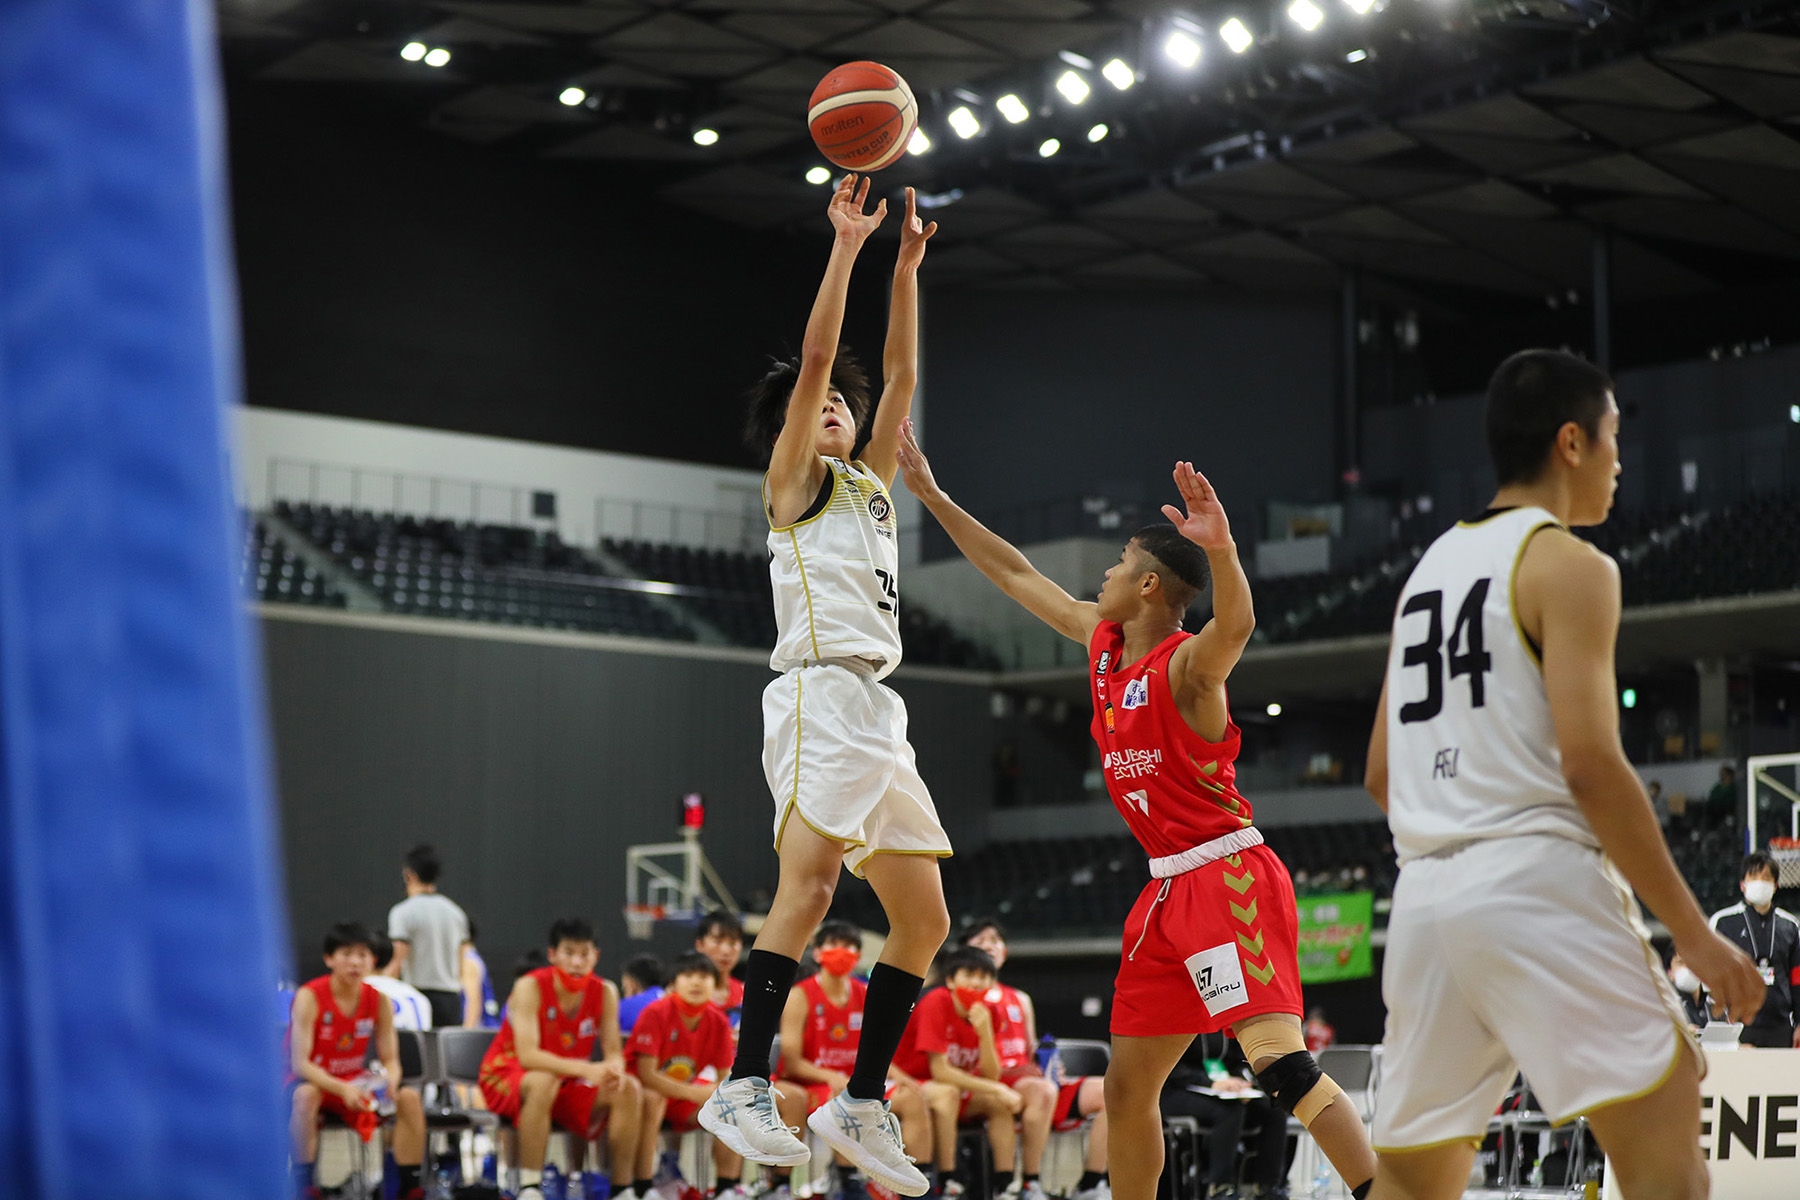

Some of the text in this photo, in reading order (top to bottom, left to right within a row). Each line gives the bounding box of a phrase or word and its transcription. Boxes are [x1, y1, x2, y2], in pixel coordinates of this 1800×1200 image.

[821, 115, 864, 137] molten
[870, 130, 889, 149] CUP
[1400, 578, 1491, 724] 34
